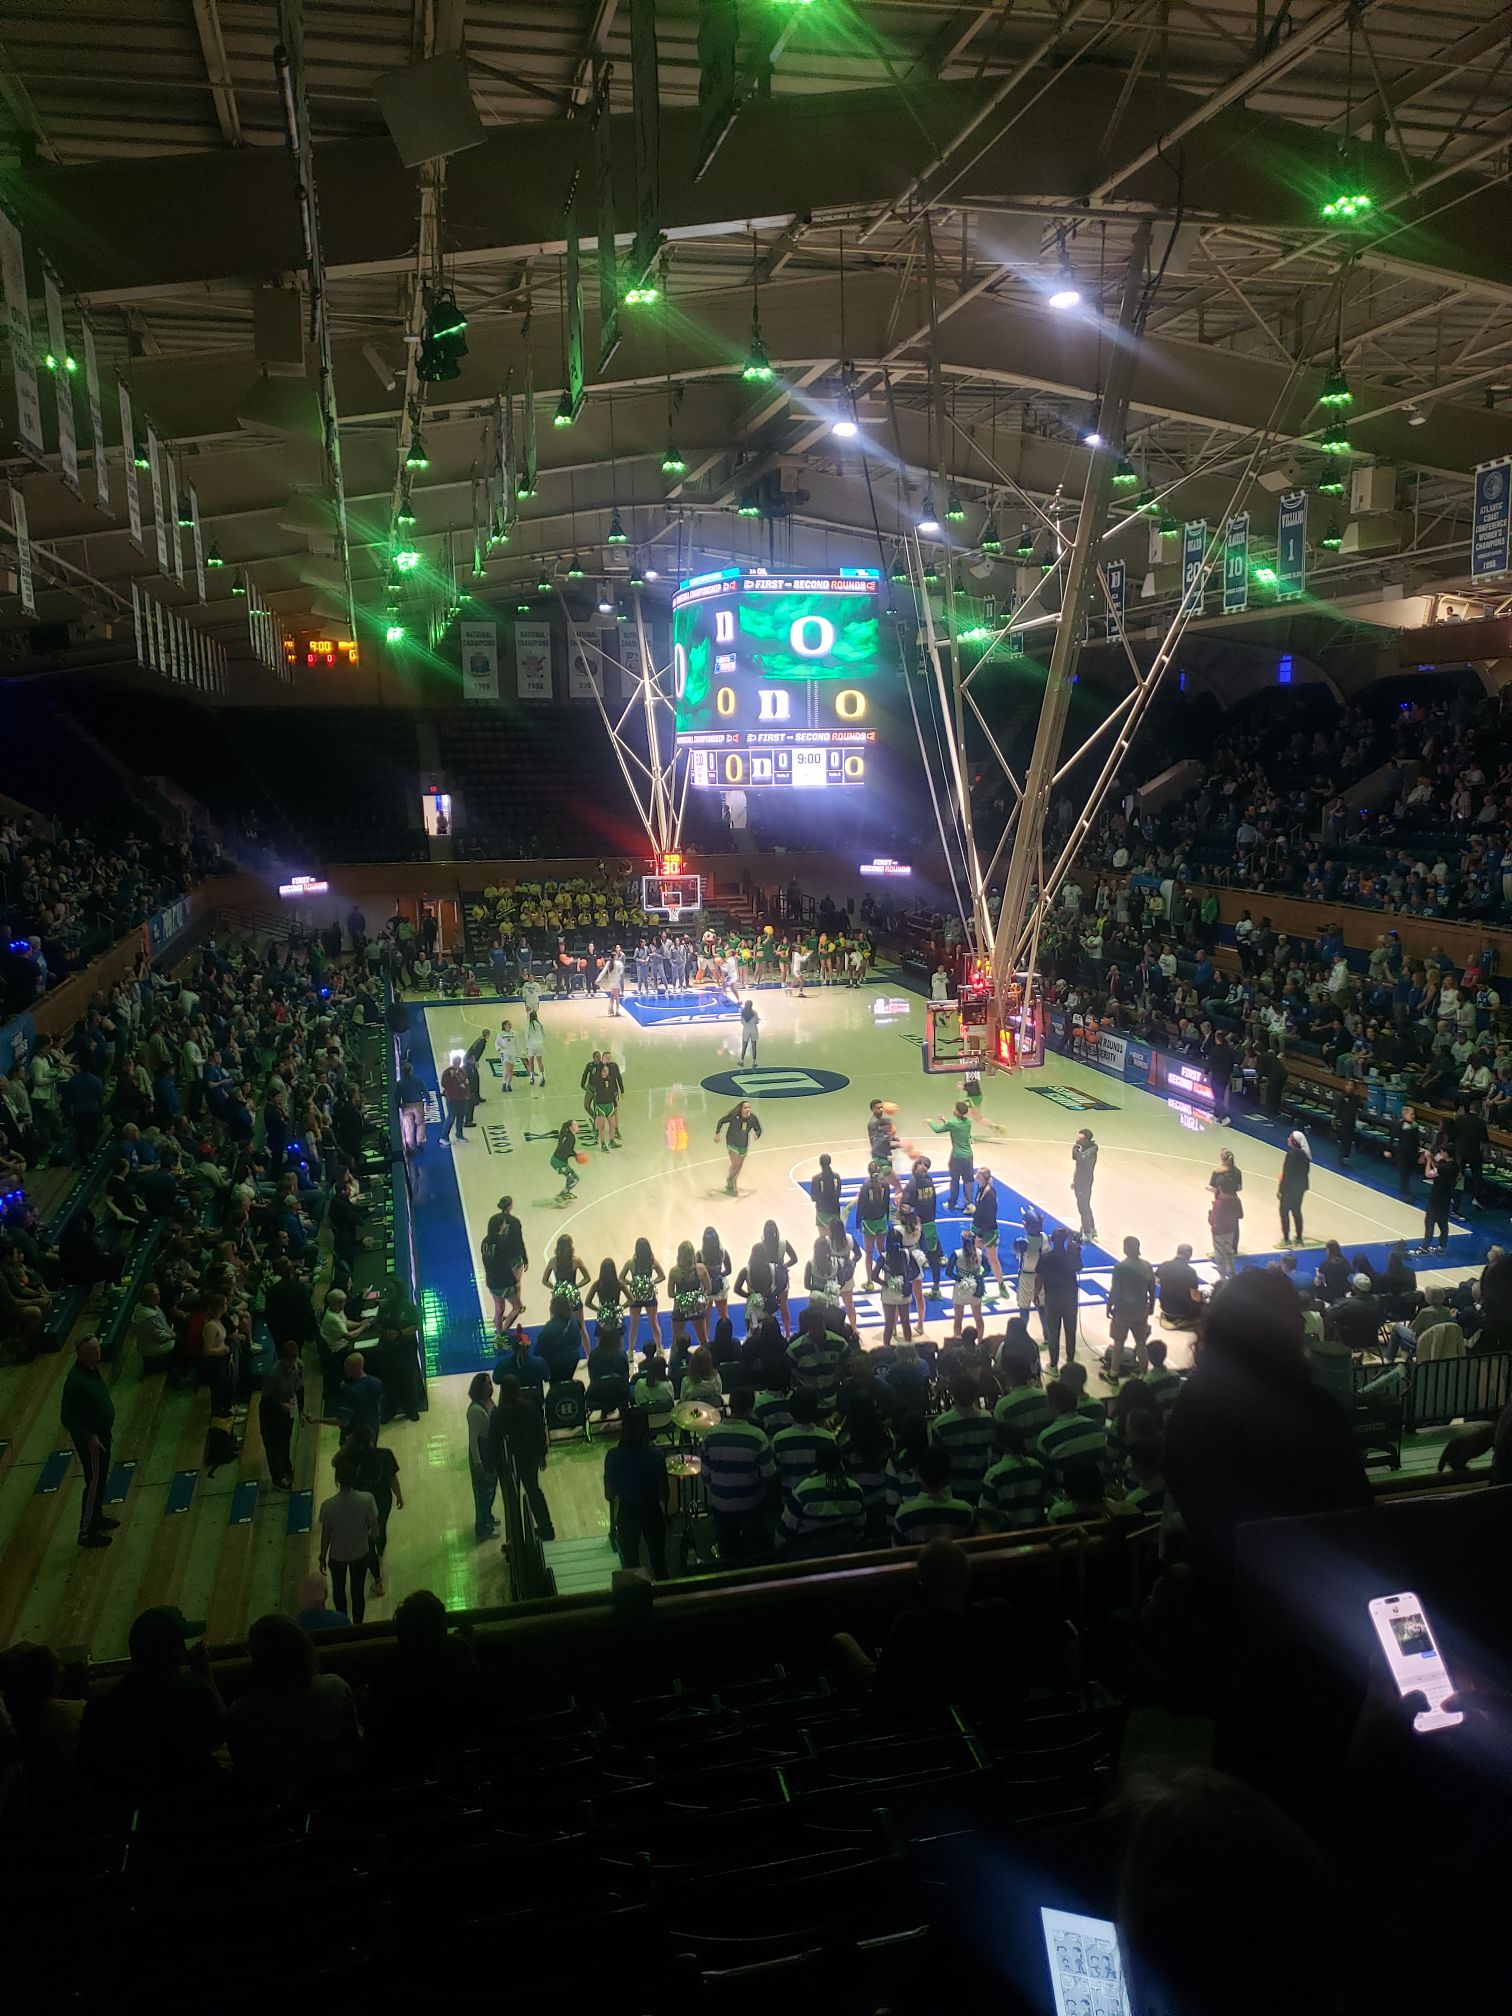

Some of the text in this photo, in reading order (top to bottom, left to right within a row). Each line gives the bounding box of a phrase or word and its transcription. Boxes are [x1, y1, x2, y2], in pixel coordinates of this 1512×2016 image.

[1480, 502, 1503, 514] ATLANTIC
[1483, 512, 1499, 522] COAST
[1476, 519, 1507, 533] CONFERENCE
[1288, 538, 1294, 561] 1
[1229, 557, 1242, 577] 10
[755, 579, 784, 589] FIRST
[793, 580, 829, 590] SECOND
[831, 581, 866, 591] ROUNDS
[791, 616, 834, 654] O
[795, 733, 830, 741] SECOND
[831, 732, 866, 740] ROUNDS
[779, 753, 787, 768] 0
[797, 754, 821, 764] 9:00
[830, 752, 838, 766] 0
[663, 862, 678, 874] 30
[1103, 1038, 1123, 1054] ROUNDS
[1181, 1066, 1201, 1081] FIRST
[1168, 1072, 1193, 1091] SECOND
[488, 1125, 513, 1153] COACH
